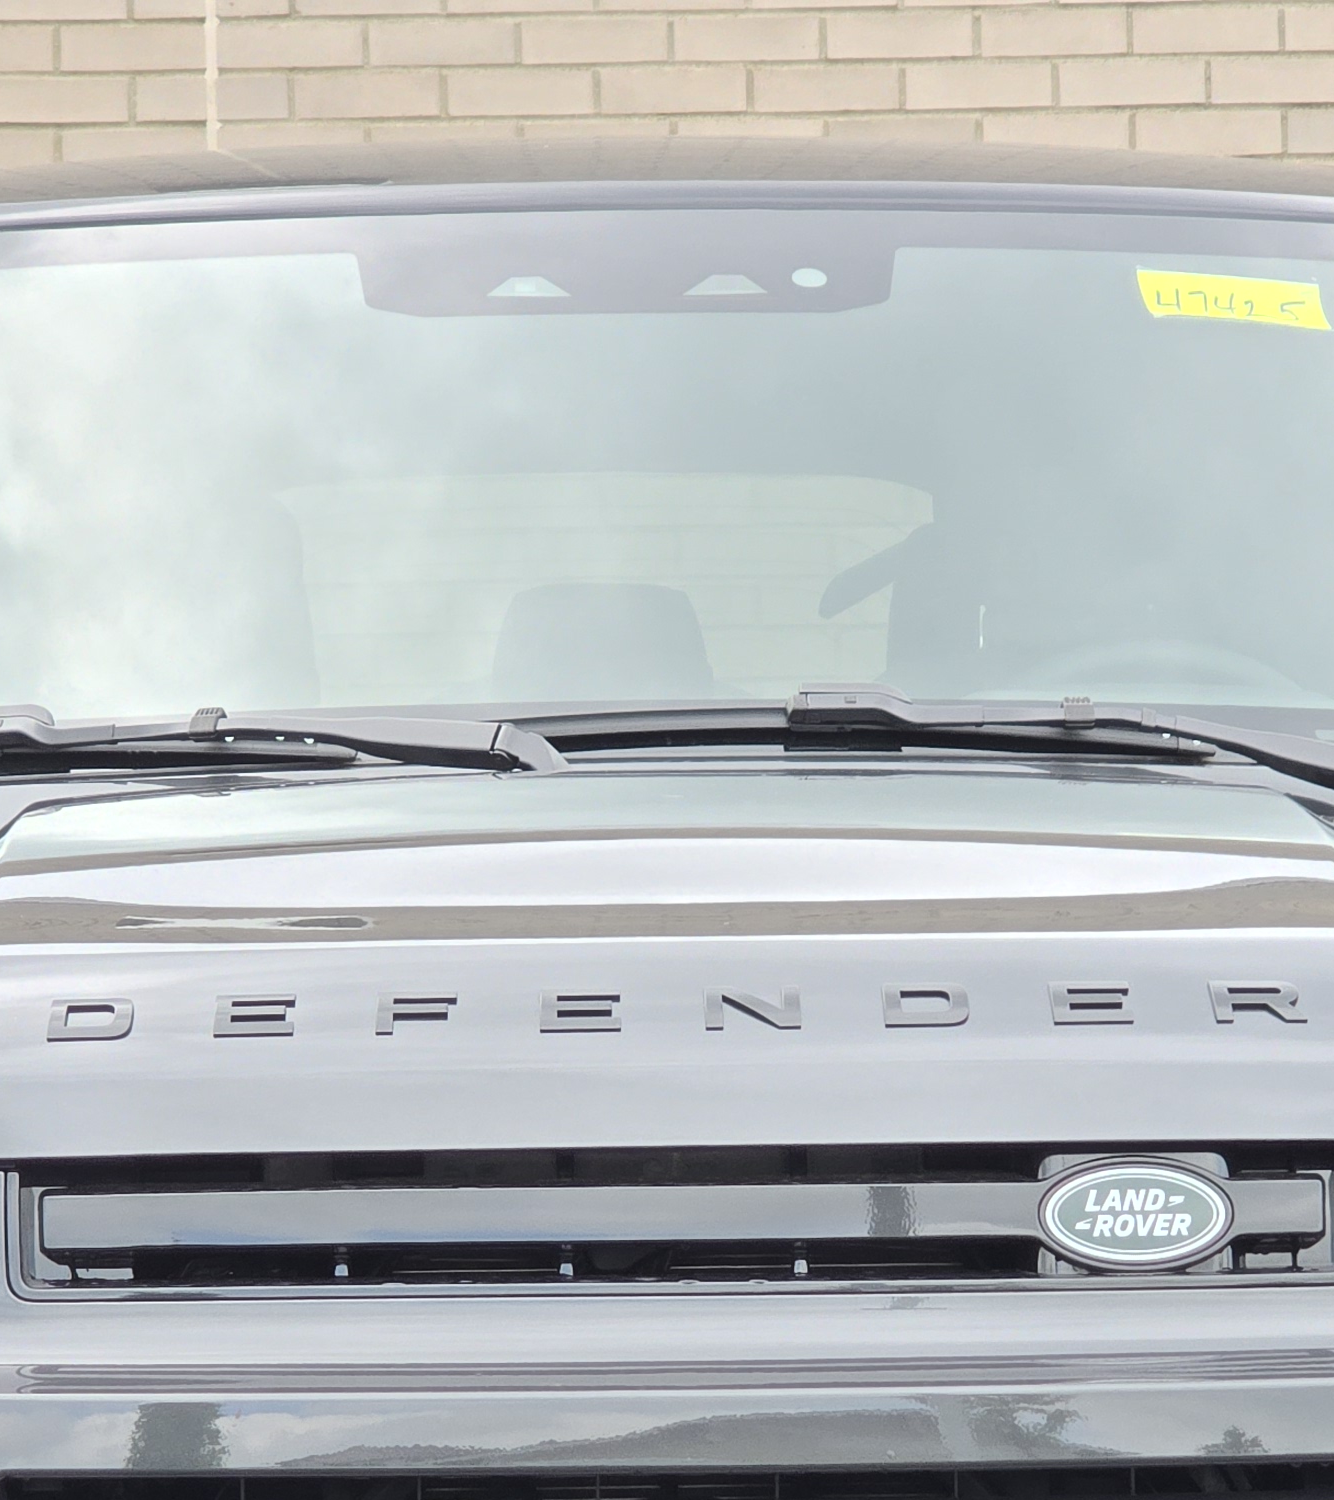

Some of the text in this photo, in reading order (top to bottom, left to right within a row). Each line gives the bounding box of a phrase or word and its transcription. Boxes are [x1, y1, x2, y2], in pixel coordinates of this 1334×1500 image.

[1155, 287, 1306, 321] 47425
[46, 980, 1308, 1042] DEFENDER
[1084, 1188, 1166, 1213] LAND
[1092, 1213, 1192, 1238] ROVER
